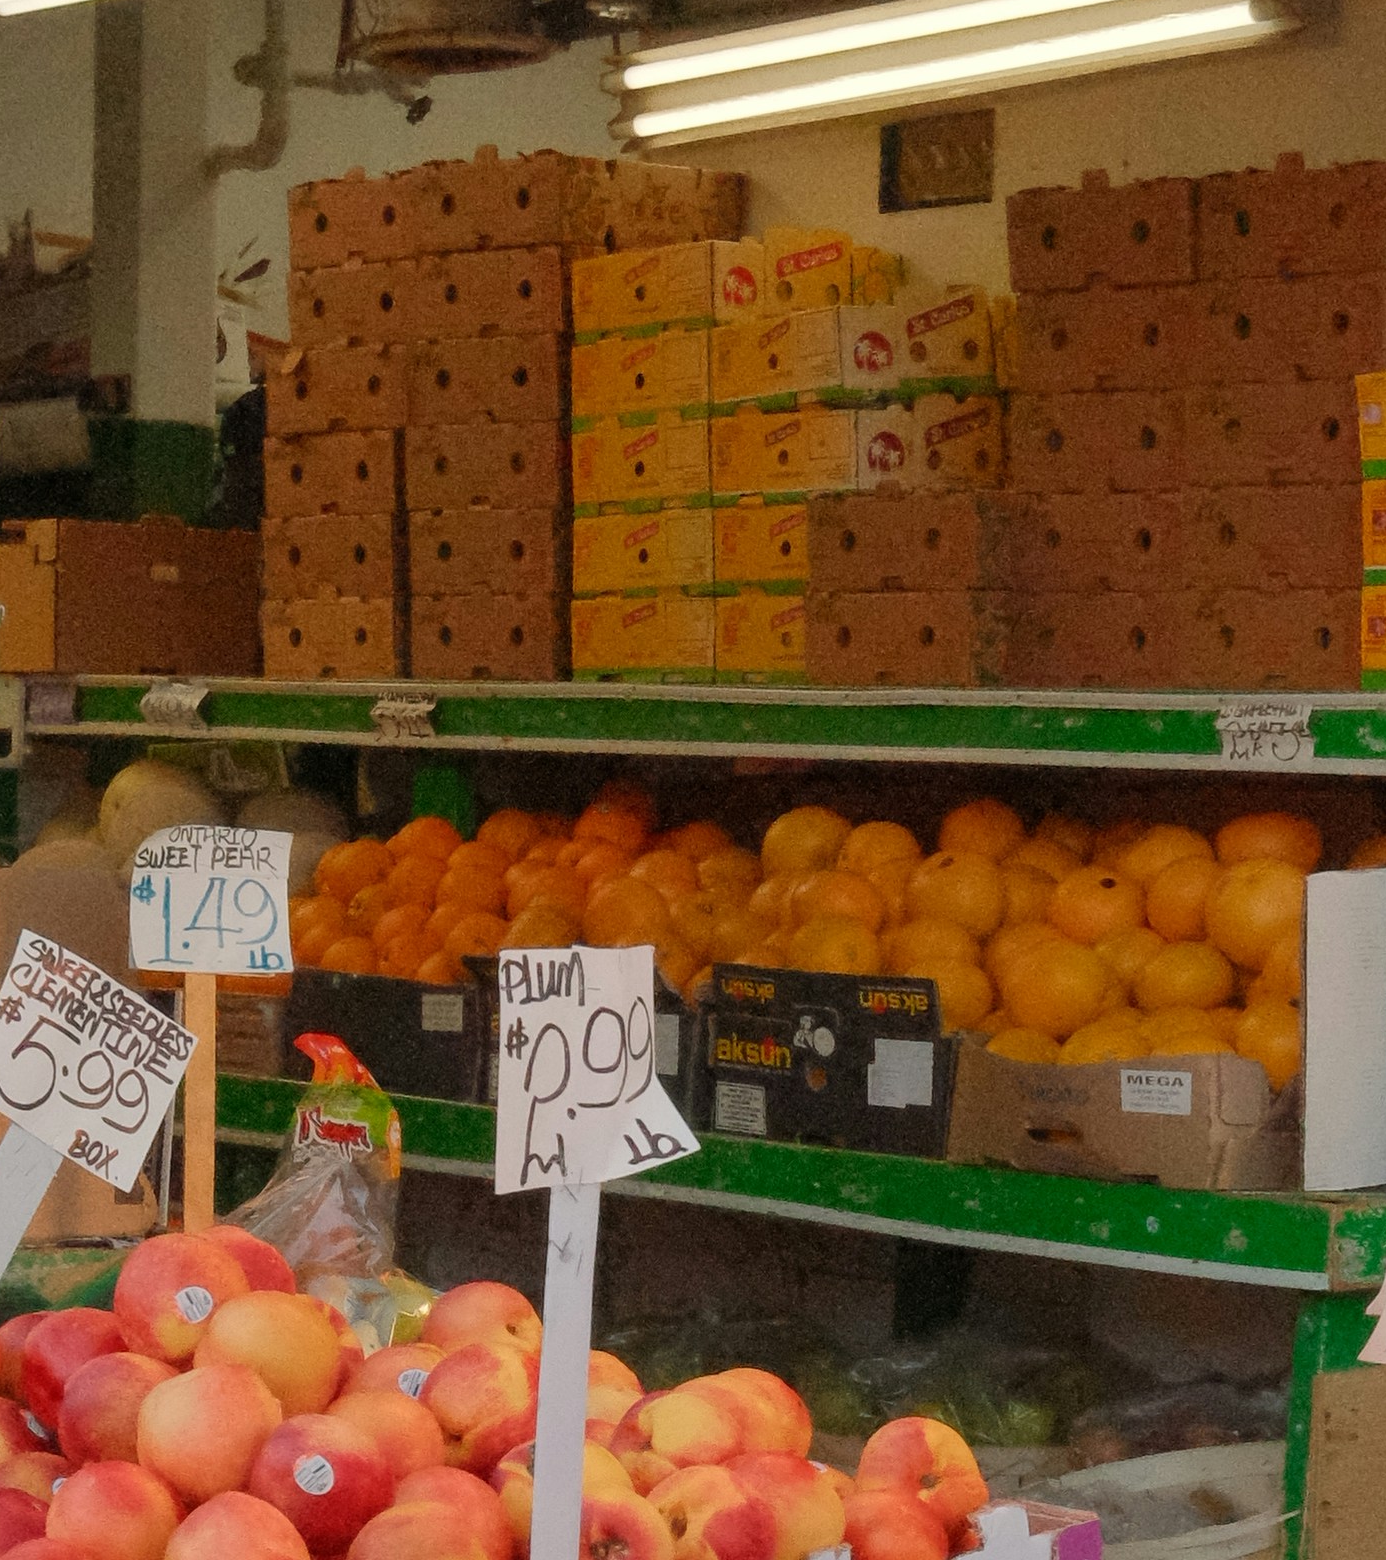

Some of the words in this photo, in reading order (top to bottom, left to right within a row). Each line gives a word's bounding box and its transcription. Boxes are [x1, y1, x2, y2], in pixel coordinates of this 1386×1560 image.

[169, 826, 258, 848] ONTARIO
[133, 846, 201, 871] SWEET
[211, 845, 276, 871] PEAR
[502, 952, 585, 1006] PLUM
[10, 962, 174, 1085] CLEMENTINE
[716, 1032, 791, 1079] aksun
[1127, 1074, 1184, 1087] MEGA
